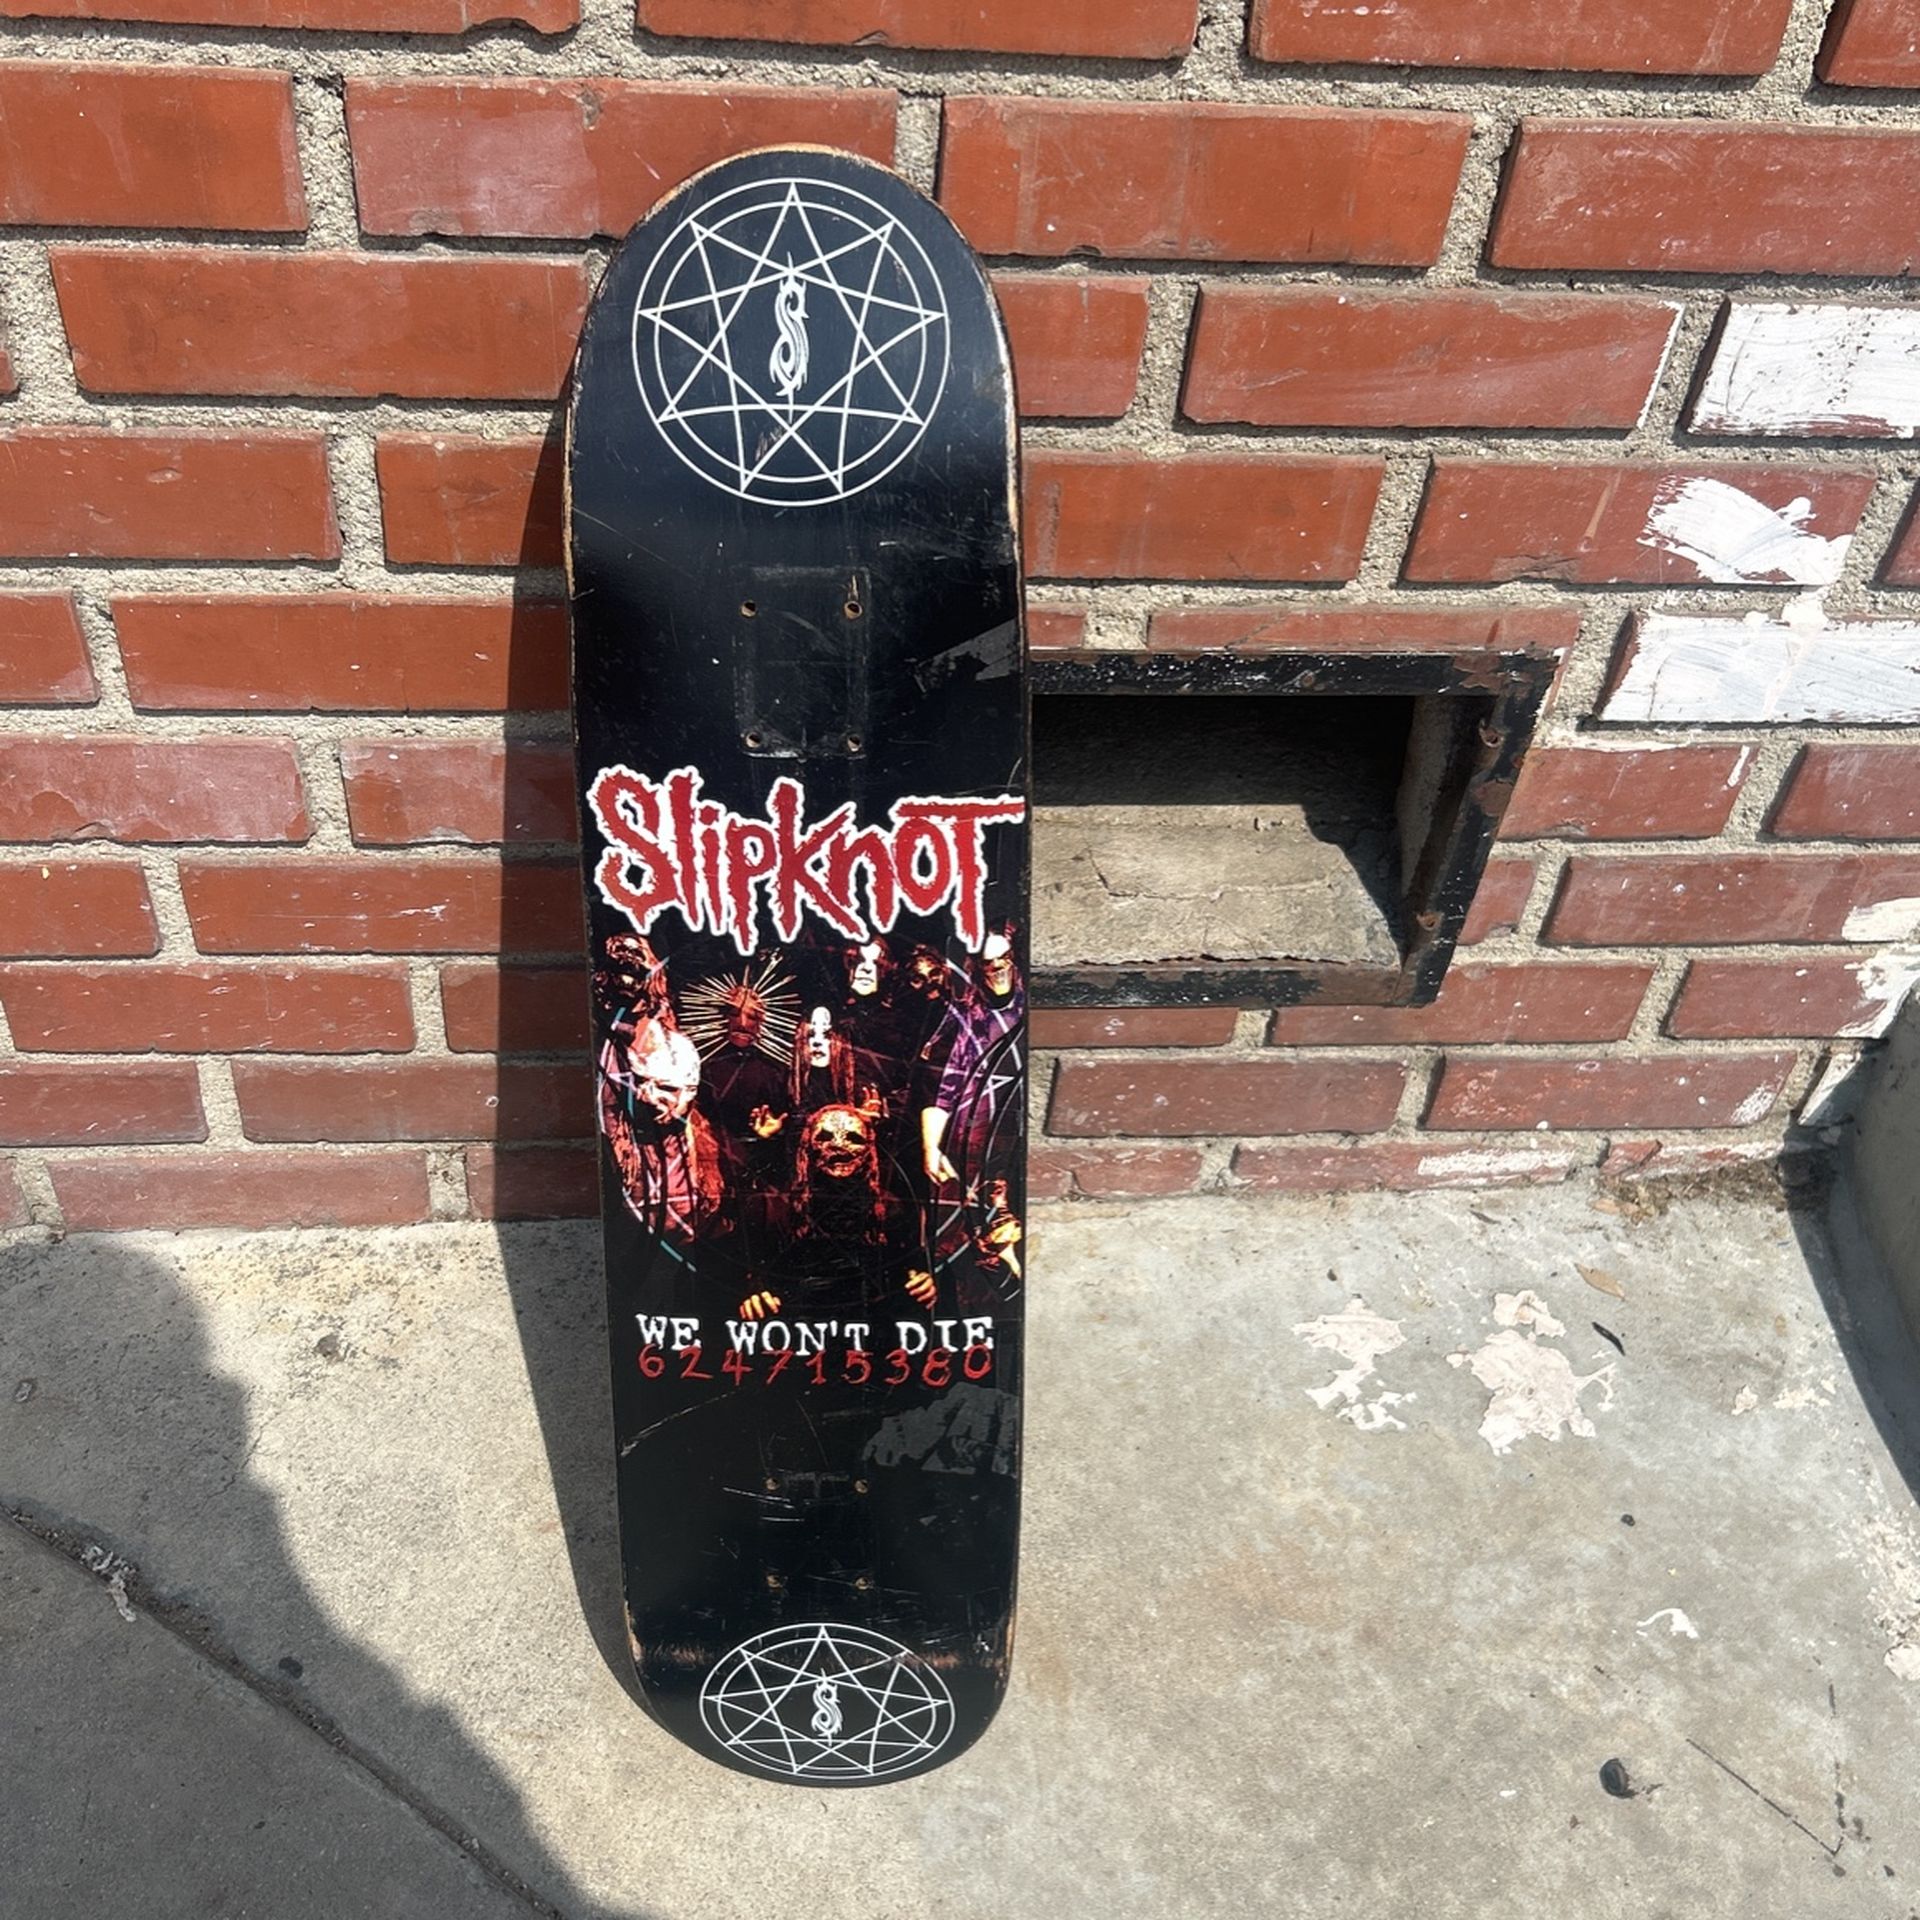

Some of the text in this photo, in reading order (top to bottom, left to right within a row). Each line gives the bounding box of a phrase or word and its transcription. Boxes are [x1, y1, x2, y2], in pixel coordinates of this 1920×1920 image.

[635, 1313, 994, 1356] WE WON'T DIE
